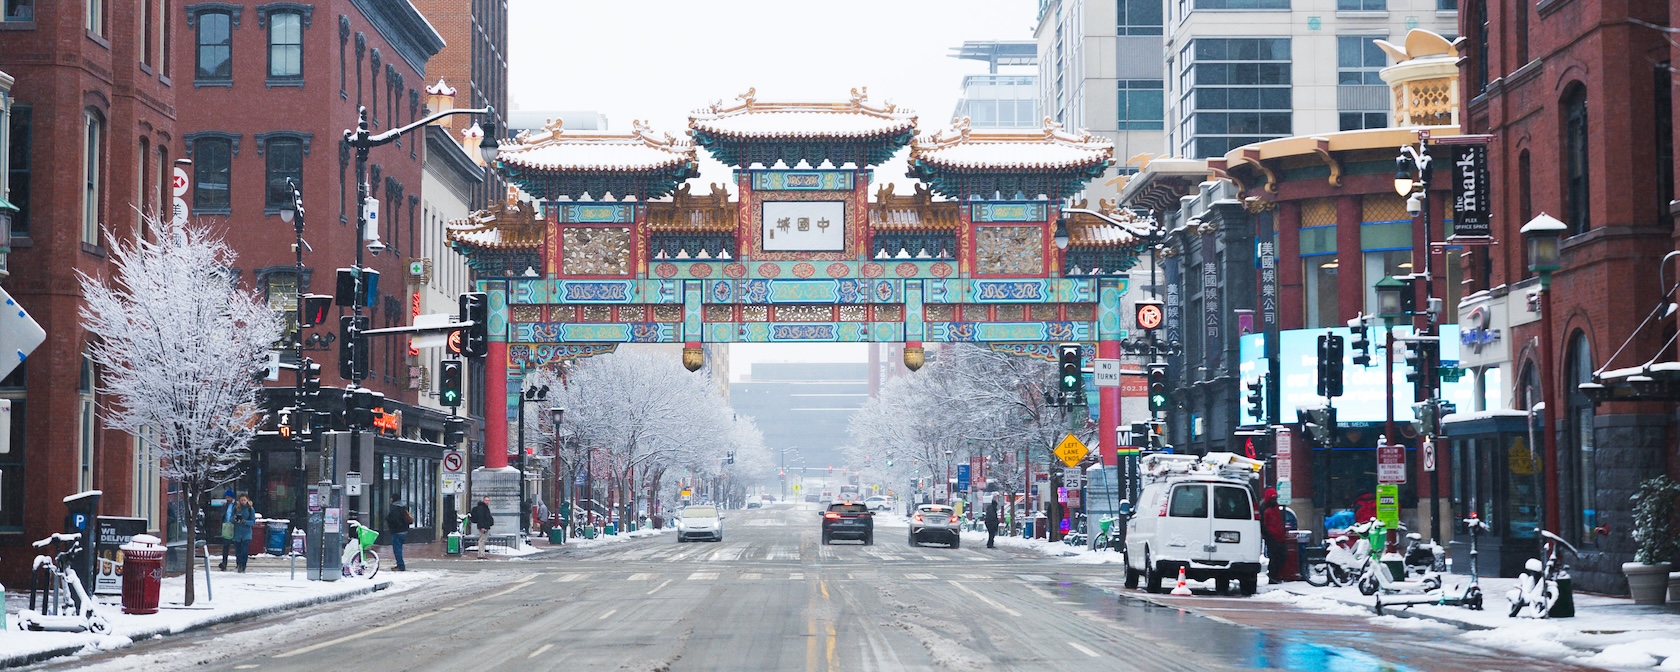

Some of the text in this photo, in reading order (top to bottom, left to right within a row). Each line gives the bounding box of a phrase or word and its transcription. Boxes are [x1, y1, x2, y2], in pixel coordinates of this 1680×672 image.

[1455, 195, 1463, 212] the
[1167, 284, 1179, 340] 美國娛樂公
[1352, 368, 1402, 385] deas
[1117, 432, 1129, 446] M
[1066, 479, 1079, 488] 25
[76, 515, 84, 527] P
